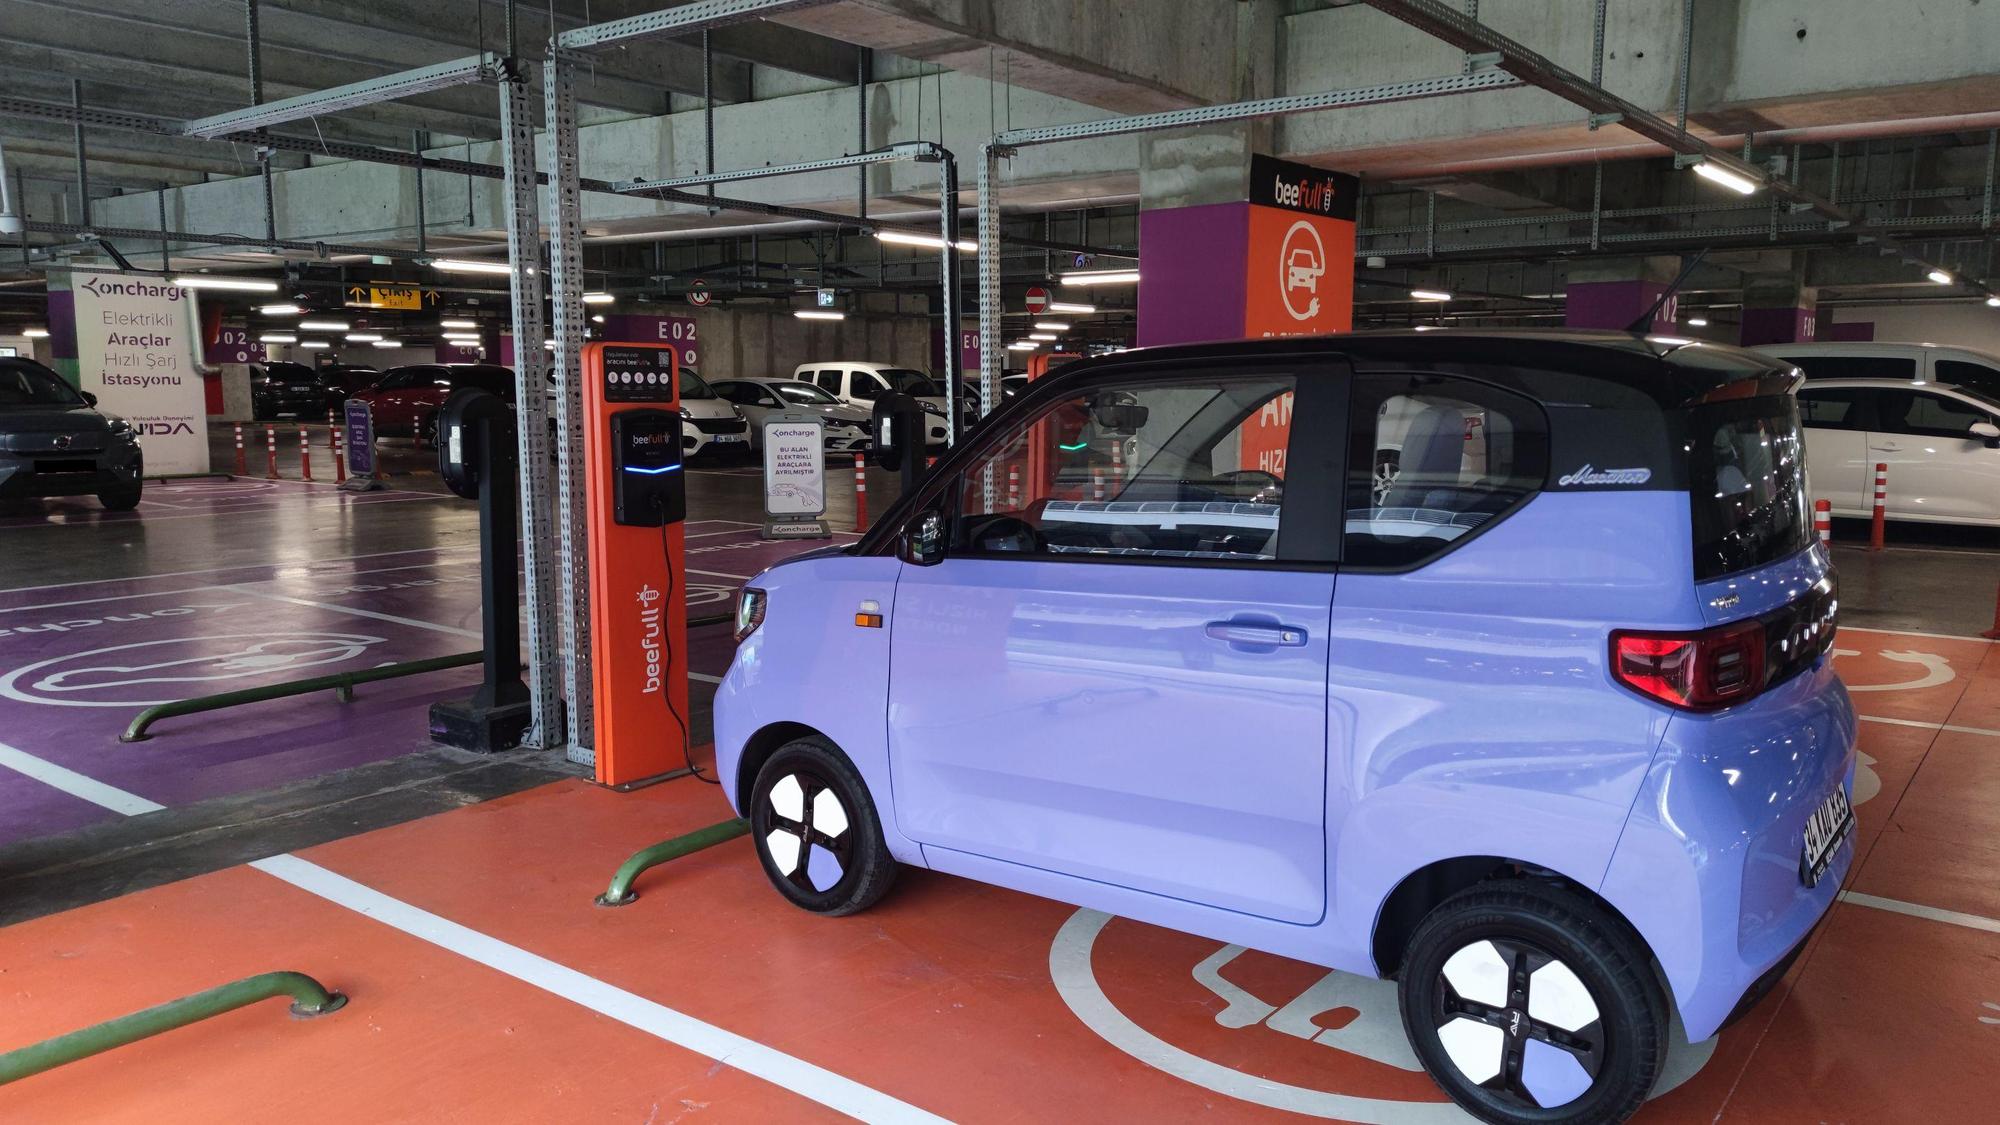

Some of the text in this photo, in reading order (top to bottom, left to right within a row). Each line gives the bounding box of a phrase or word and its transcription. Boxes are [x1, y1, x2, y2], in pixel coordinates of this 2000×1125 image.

[1275, 174, 1322, 210] beefull
[103, 310, 173, 327] Elektrikli
[658, 321, 696, 340] E02
[107, 332, 172, 350] Araçlar
[963, 334, 979, 349] E0
[104, 353, 177, 370] Hızlı Şarj
[102, 369, 181, 388] İstasyonu
[779, 430, 815, 438] oncharge
[641, 607, 660, 693] beefull
